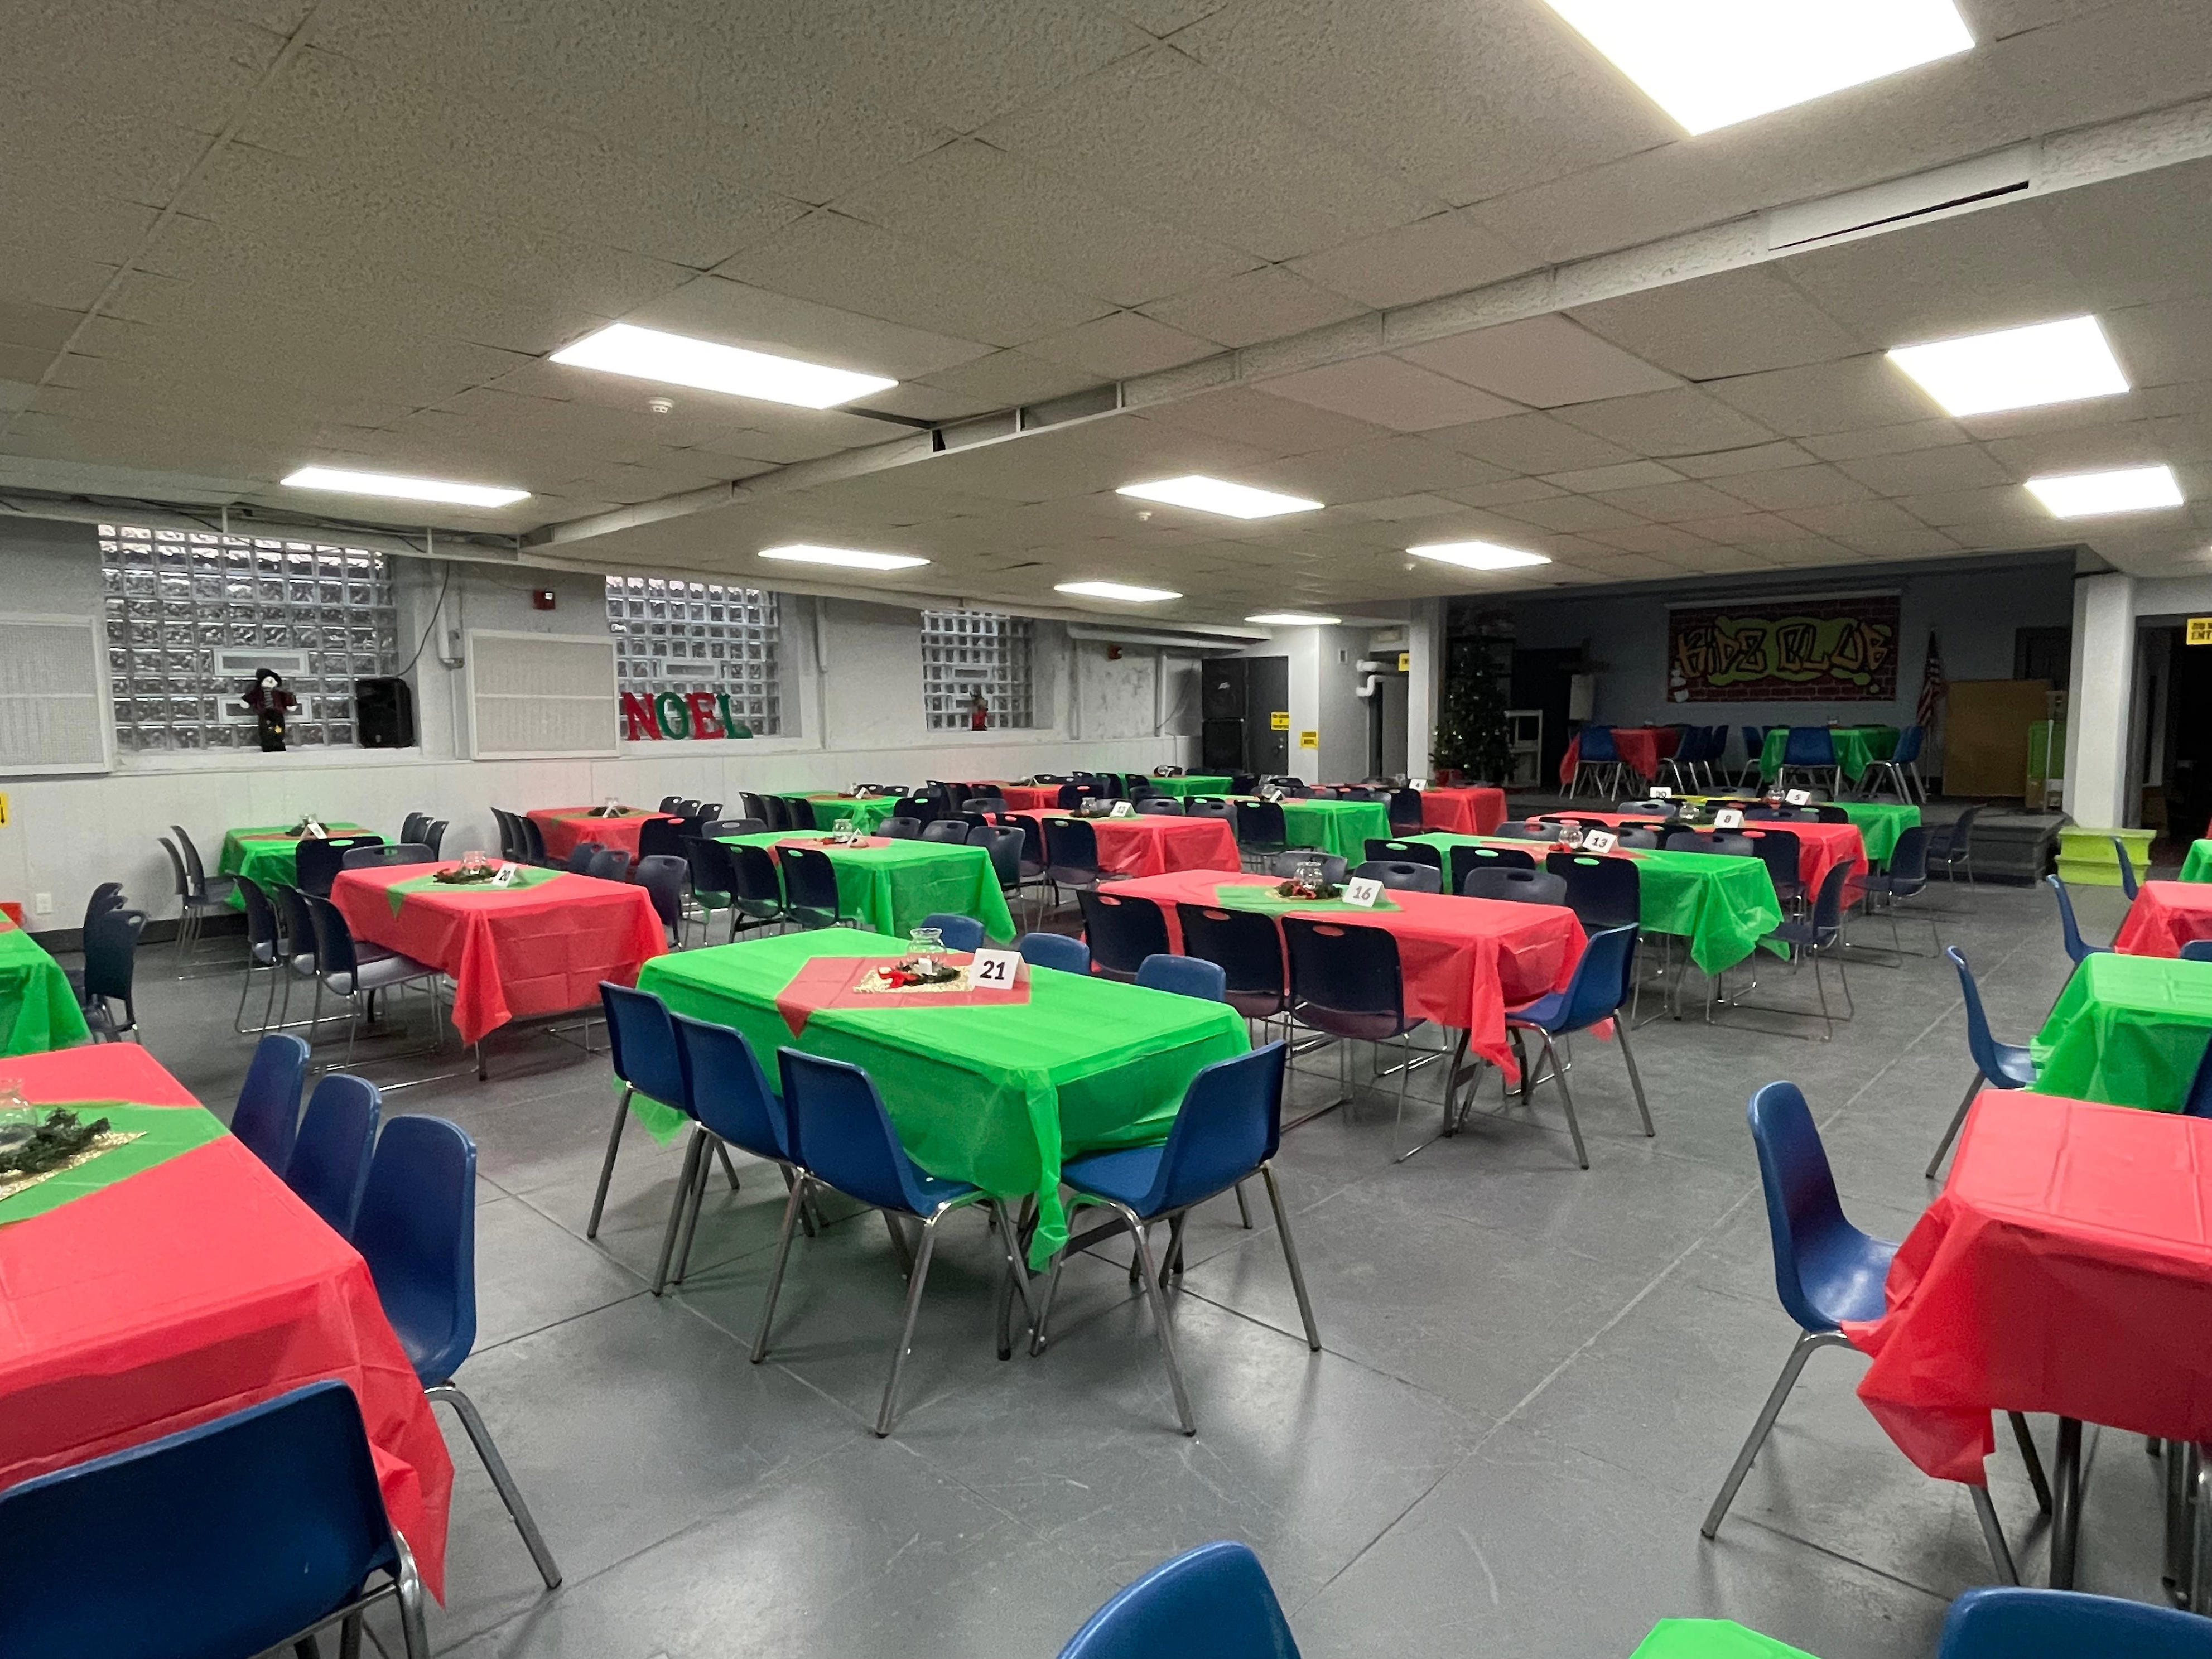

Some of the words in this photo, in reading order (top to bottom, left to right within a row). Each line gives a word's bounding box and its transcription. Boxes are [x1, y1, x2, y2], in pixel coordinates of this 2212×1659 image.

[1776, 621, 1888, 671] CLUB
[620, 691, 753, 740] NOEL
[1724, 815, 1731, 823] 8
[1591, 837, 1608, 848] 13
[499, 870, 511, 881] 20
[1353, 886, 1372, 901] 16
[979, 960, 1005, 980] 21
